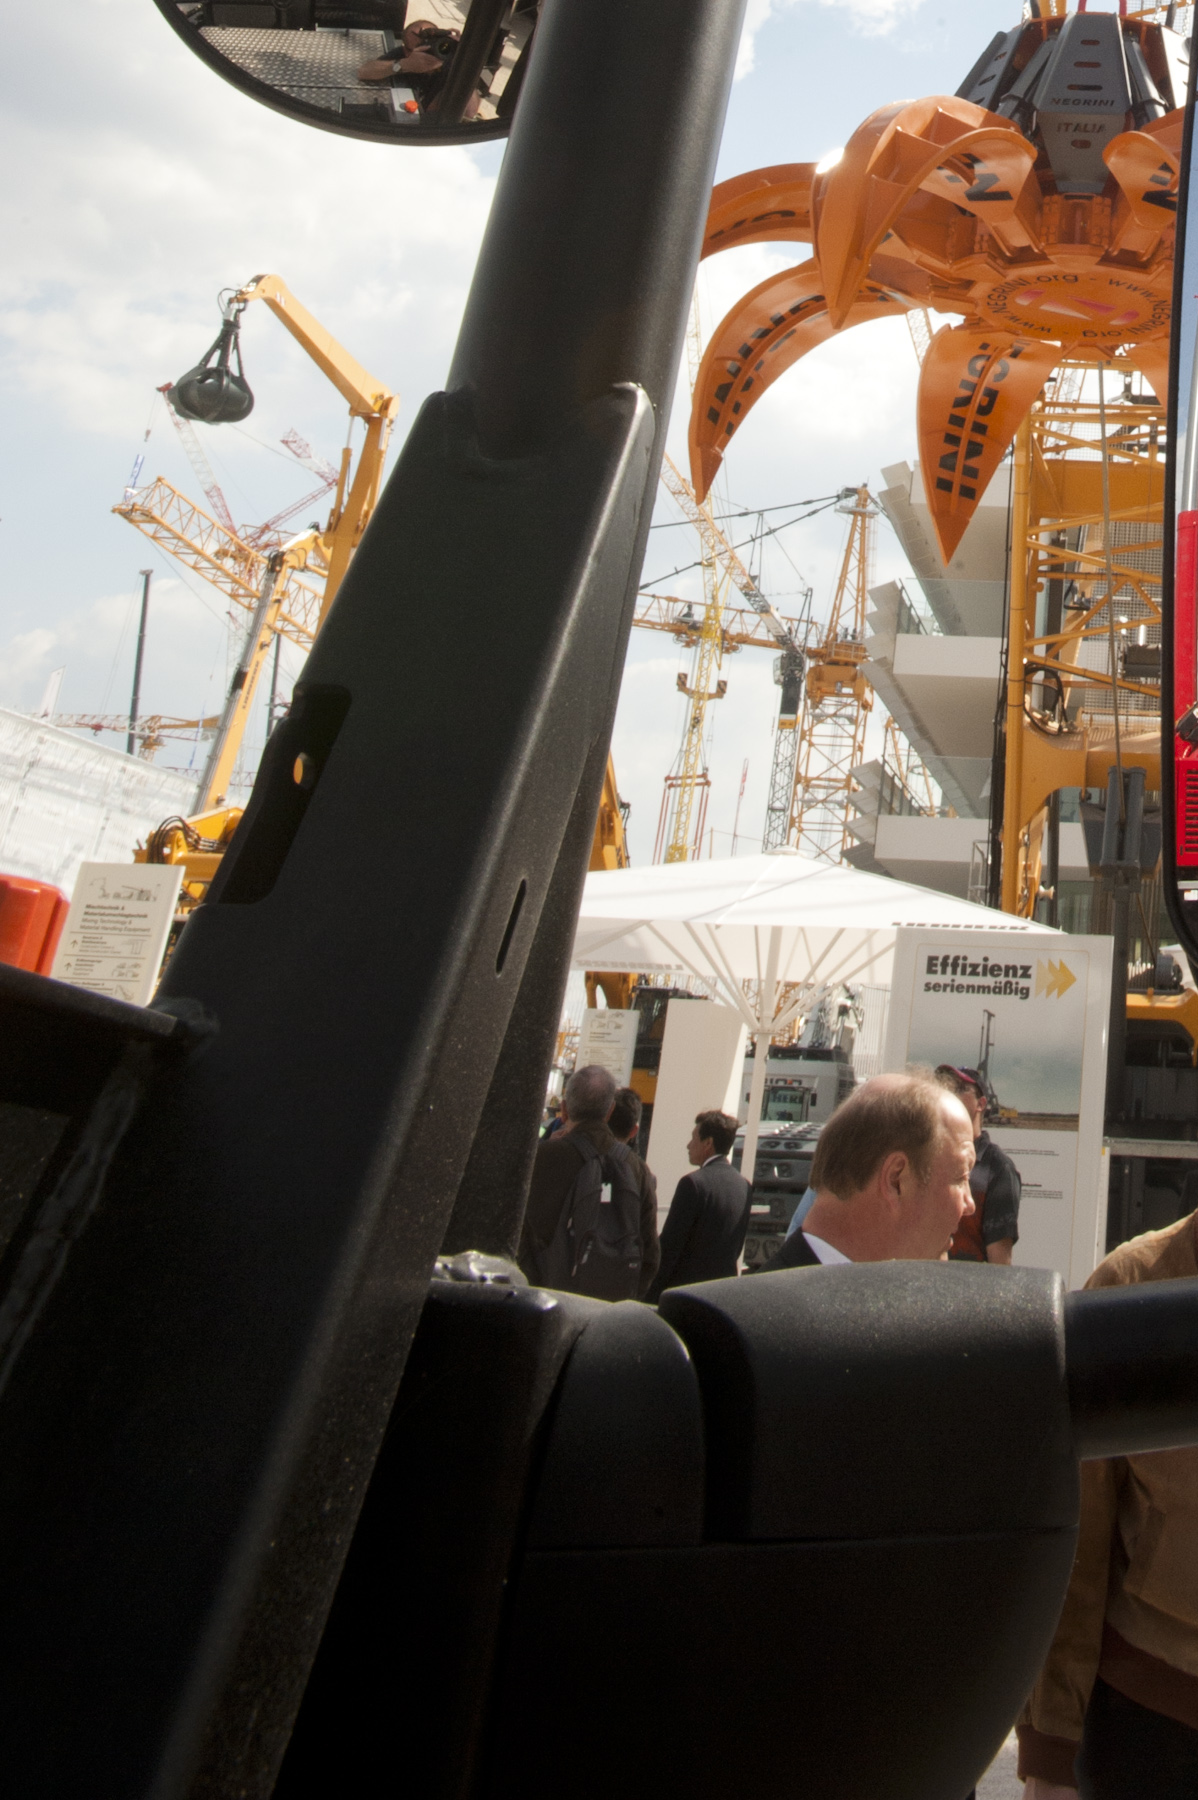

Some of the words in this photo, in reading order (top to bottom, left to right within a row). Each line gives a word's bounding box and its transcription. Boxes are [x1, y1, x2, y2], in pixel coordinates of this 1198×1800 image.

[1051, 98, 1115, 108] NEGRINI
[1056, 122, 1107, 134] ITALIA
[925, 955, 1033, 979] Effizienz
[923, 979, 1031, 1000] serienmäßig
